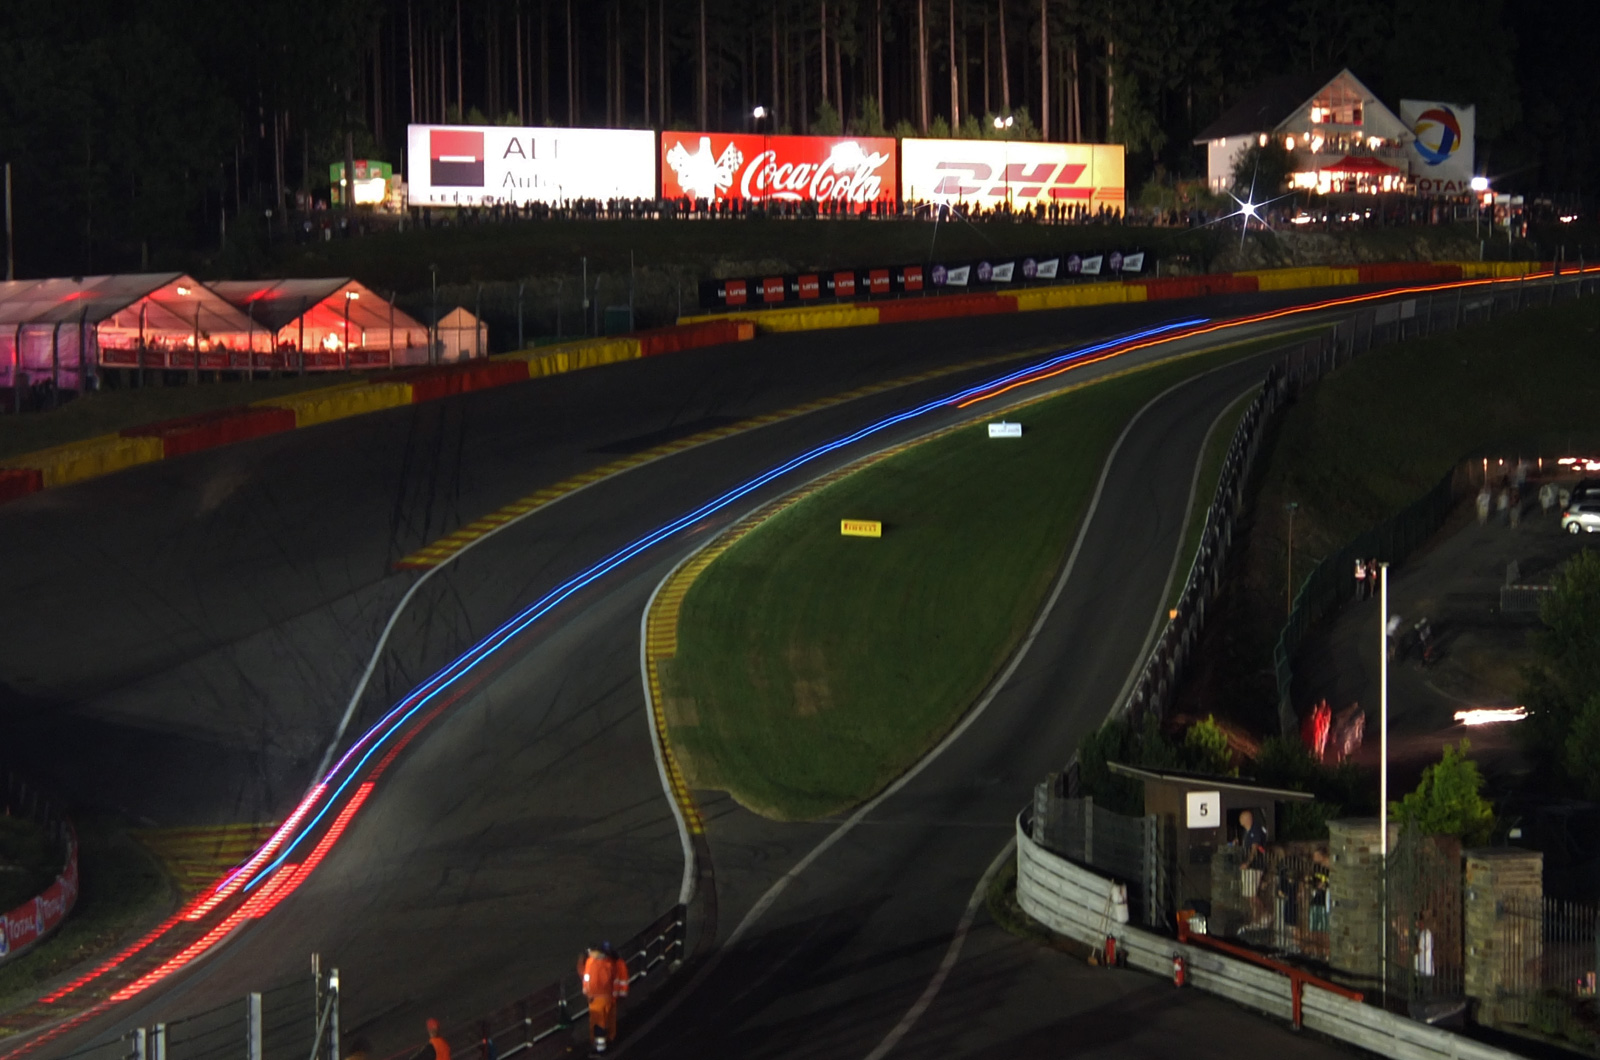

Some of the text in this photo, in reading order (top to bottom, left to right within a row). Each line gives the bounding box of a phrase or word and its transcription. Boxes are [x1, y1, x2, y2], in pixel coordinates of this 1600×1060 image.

[741, 144, 890, 204] Coca-Cola
[934, 161, 1098, 200] DHL
[1200, 803, 1208, 817] 5
